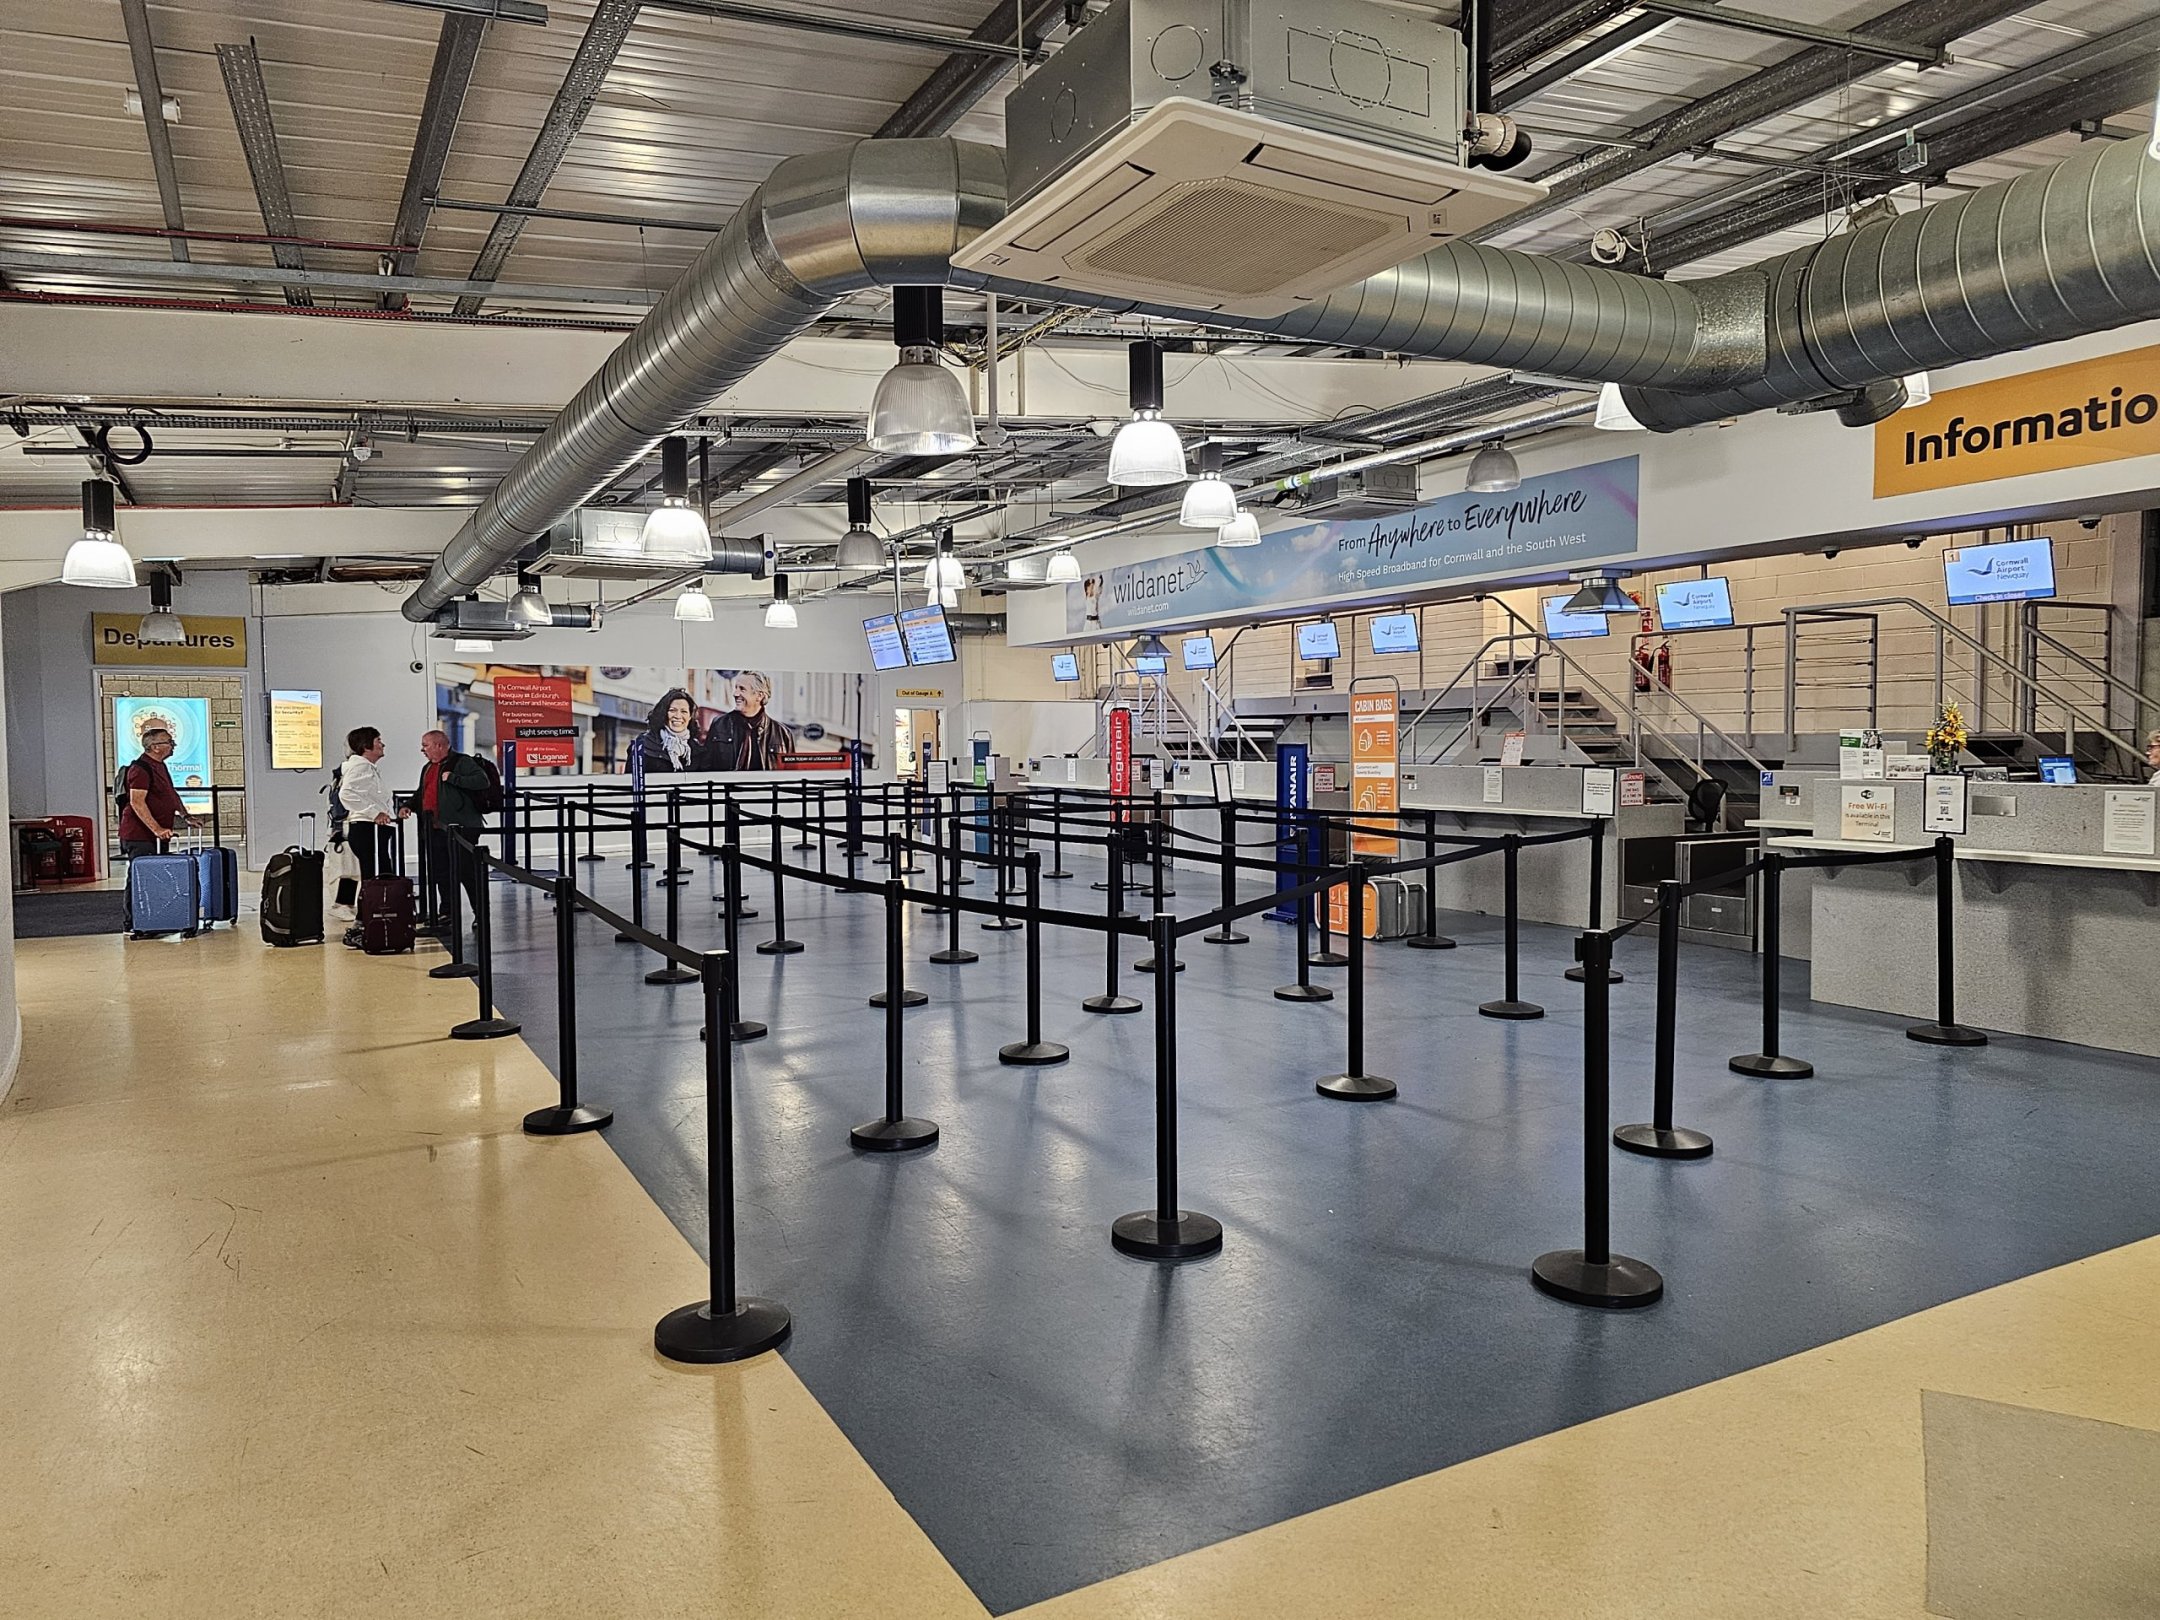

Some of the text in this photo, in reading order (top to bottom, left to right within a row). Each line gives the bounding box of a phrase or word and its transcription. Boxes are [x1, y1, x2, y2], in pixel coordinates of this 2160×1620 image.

[1905, 387, 2158, 465] Informatio
[1338, 537, 1366, 551] From
[1368, 515, 1445, 559] Anywhere
[1448, 518, 1460, 531] to
[1338, 532, 1586, 582] High Speed Broadband for Cornwall and the South West
[1996, 557, 2028, 567] Cornwall
[1996, 566, 2025, 574] Airport
[1114, 566, 1184, 604] wildanet
[1128, 602, 1169, 616] wildanet.com
[1354, 698, 1392, 712] CABIN BAGS
[1114, 716, 1124, 792] Loganair
